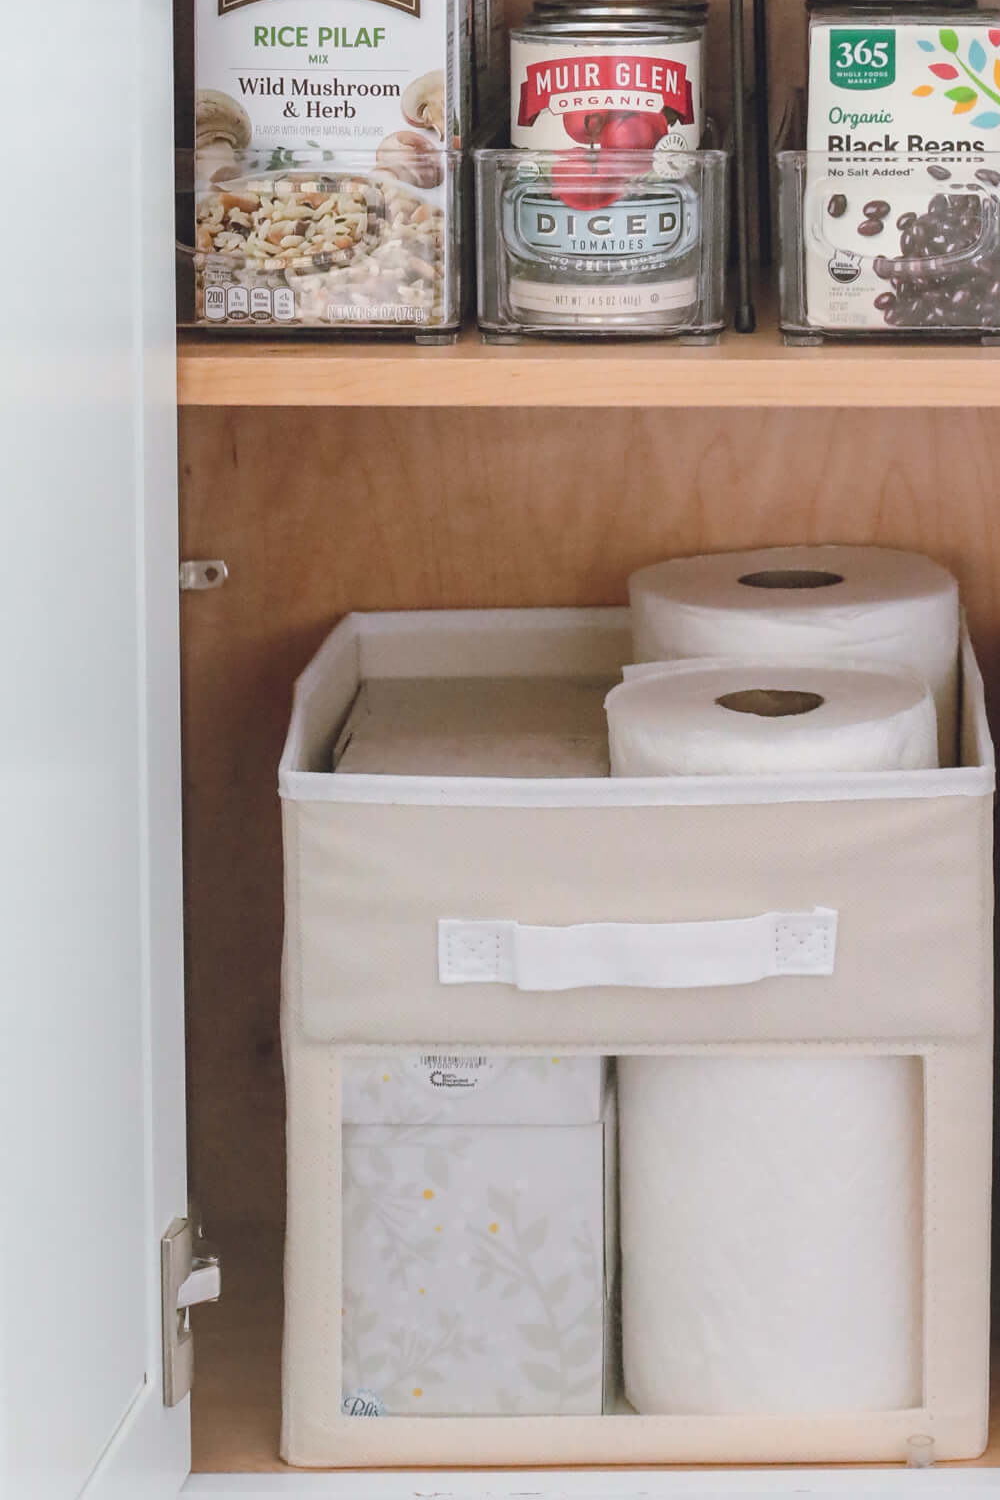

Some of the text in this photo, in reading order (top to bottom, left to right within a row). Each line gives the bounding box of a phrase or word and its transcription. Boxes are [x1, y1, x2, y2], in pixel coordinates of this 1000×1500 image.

[253, 26, 386, 48] RICE PILAF
[308, 54, 329, 65] MIX
[836, 39, 889, 68] 365
[238, 77, 400, 97] Wild Mushroom
[536, 62, 681, 96] MUIR GLEN
[282, 100, 356, 118] & Herb
[558, 96, 656, 108] ORGANIC
[828, 106, 894, 130] Organic
[827, 134, 985, 152] Black Beans
[828, 168, 844, 177] No
[847, 168, 869, 177] Salt
[537, 213, 677, 236] DICED
[571, 239, 644, 251] TOMATOES
[207, 290, 224, 304] 200
